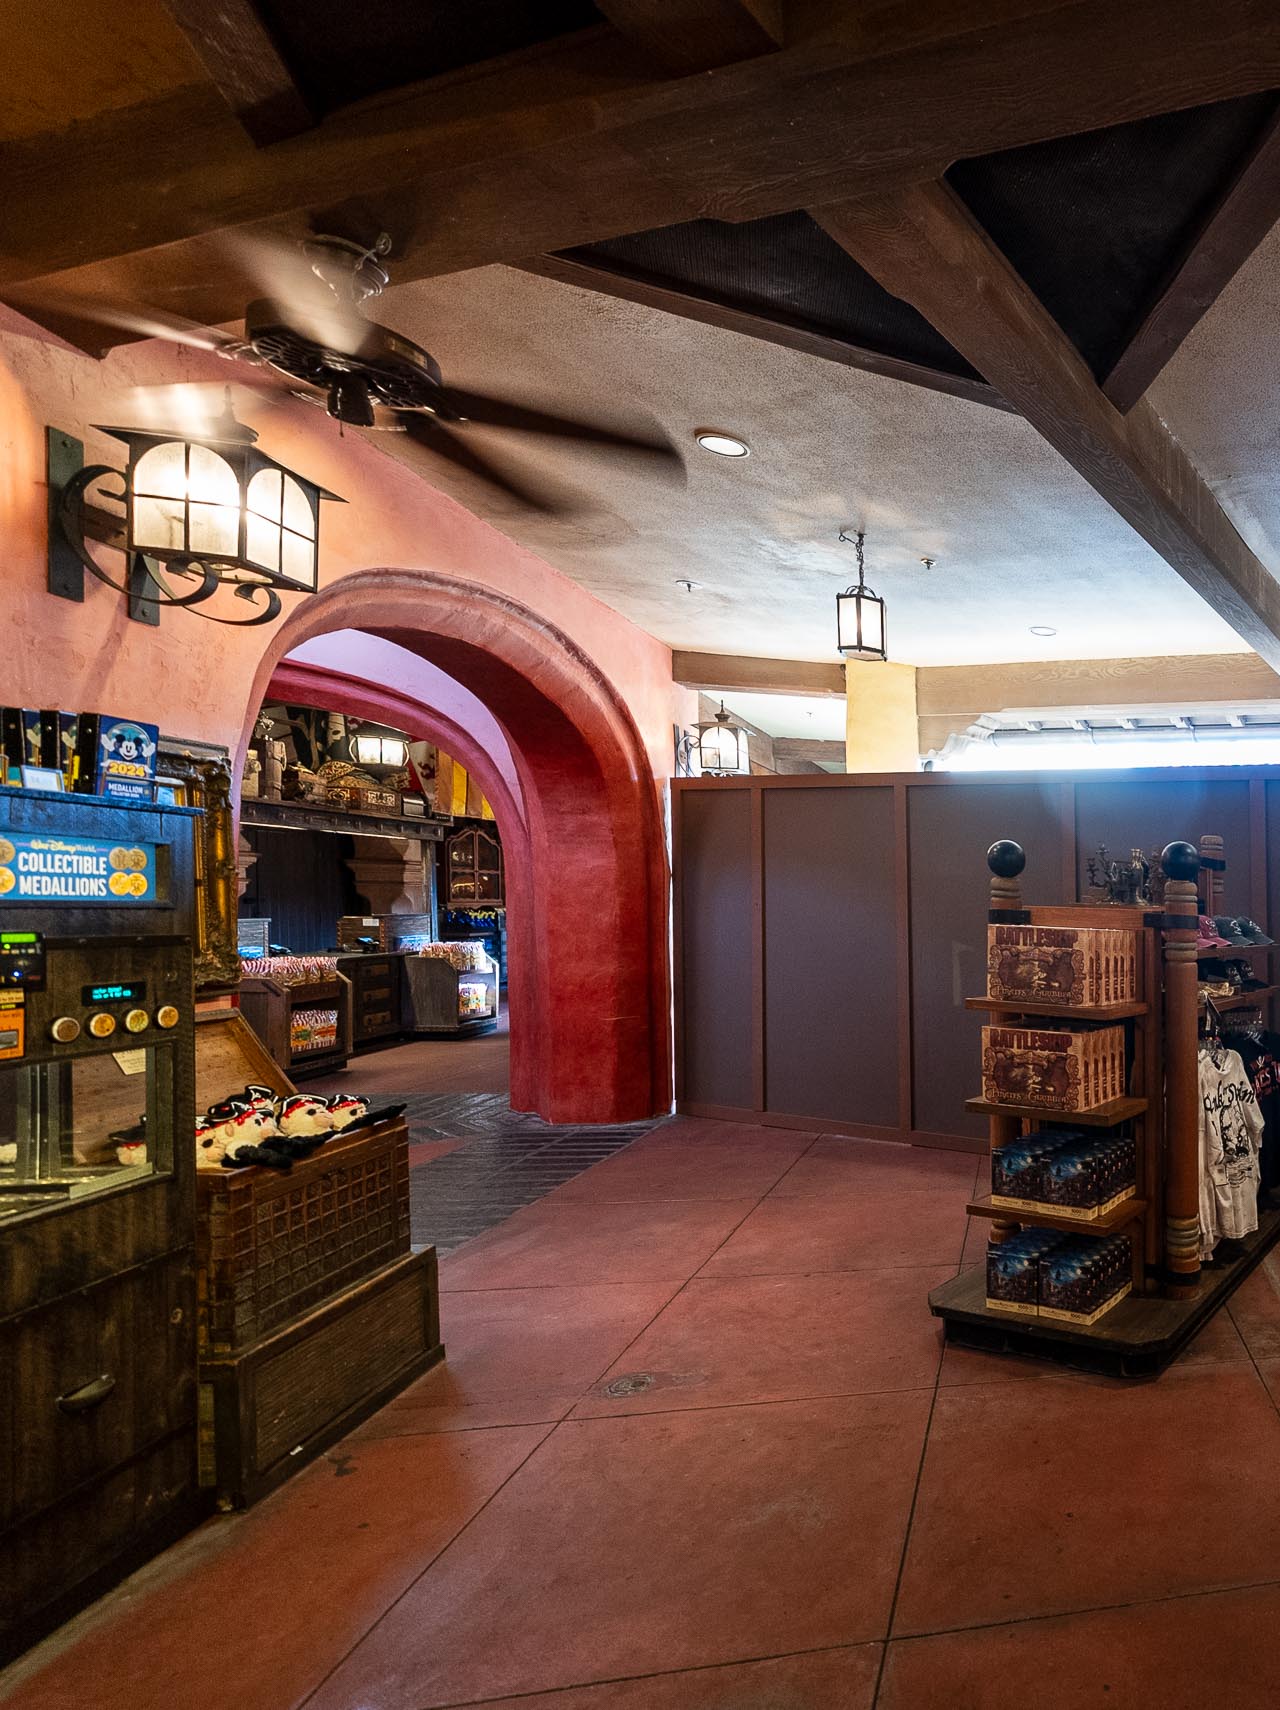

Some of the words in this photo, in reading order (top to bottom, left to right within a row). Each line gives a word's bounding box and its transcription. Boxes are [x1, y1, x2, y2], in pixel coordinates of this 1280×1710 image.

[108, 762, 146, 778] 2024
[108, 782, 144, 795] MEDALLION
[17, 851, 108, 876] COLLECTIBLE
[18, 875, 108, 897] MEDALLIONS
[995, 926, 1079, 949] BATTLESHIP
[989, 1027, 1073, 1053] BATTLESHIP
